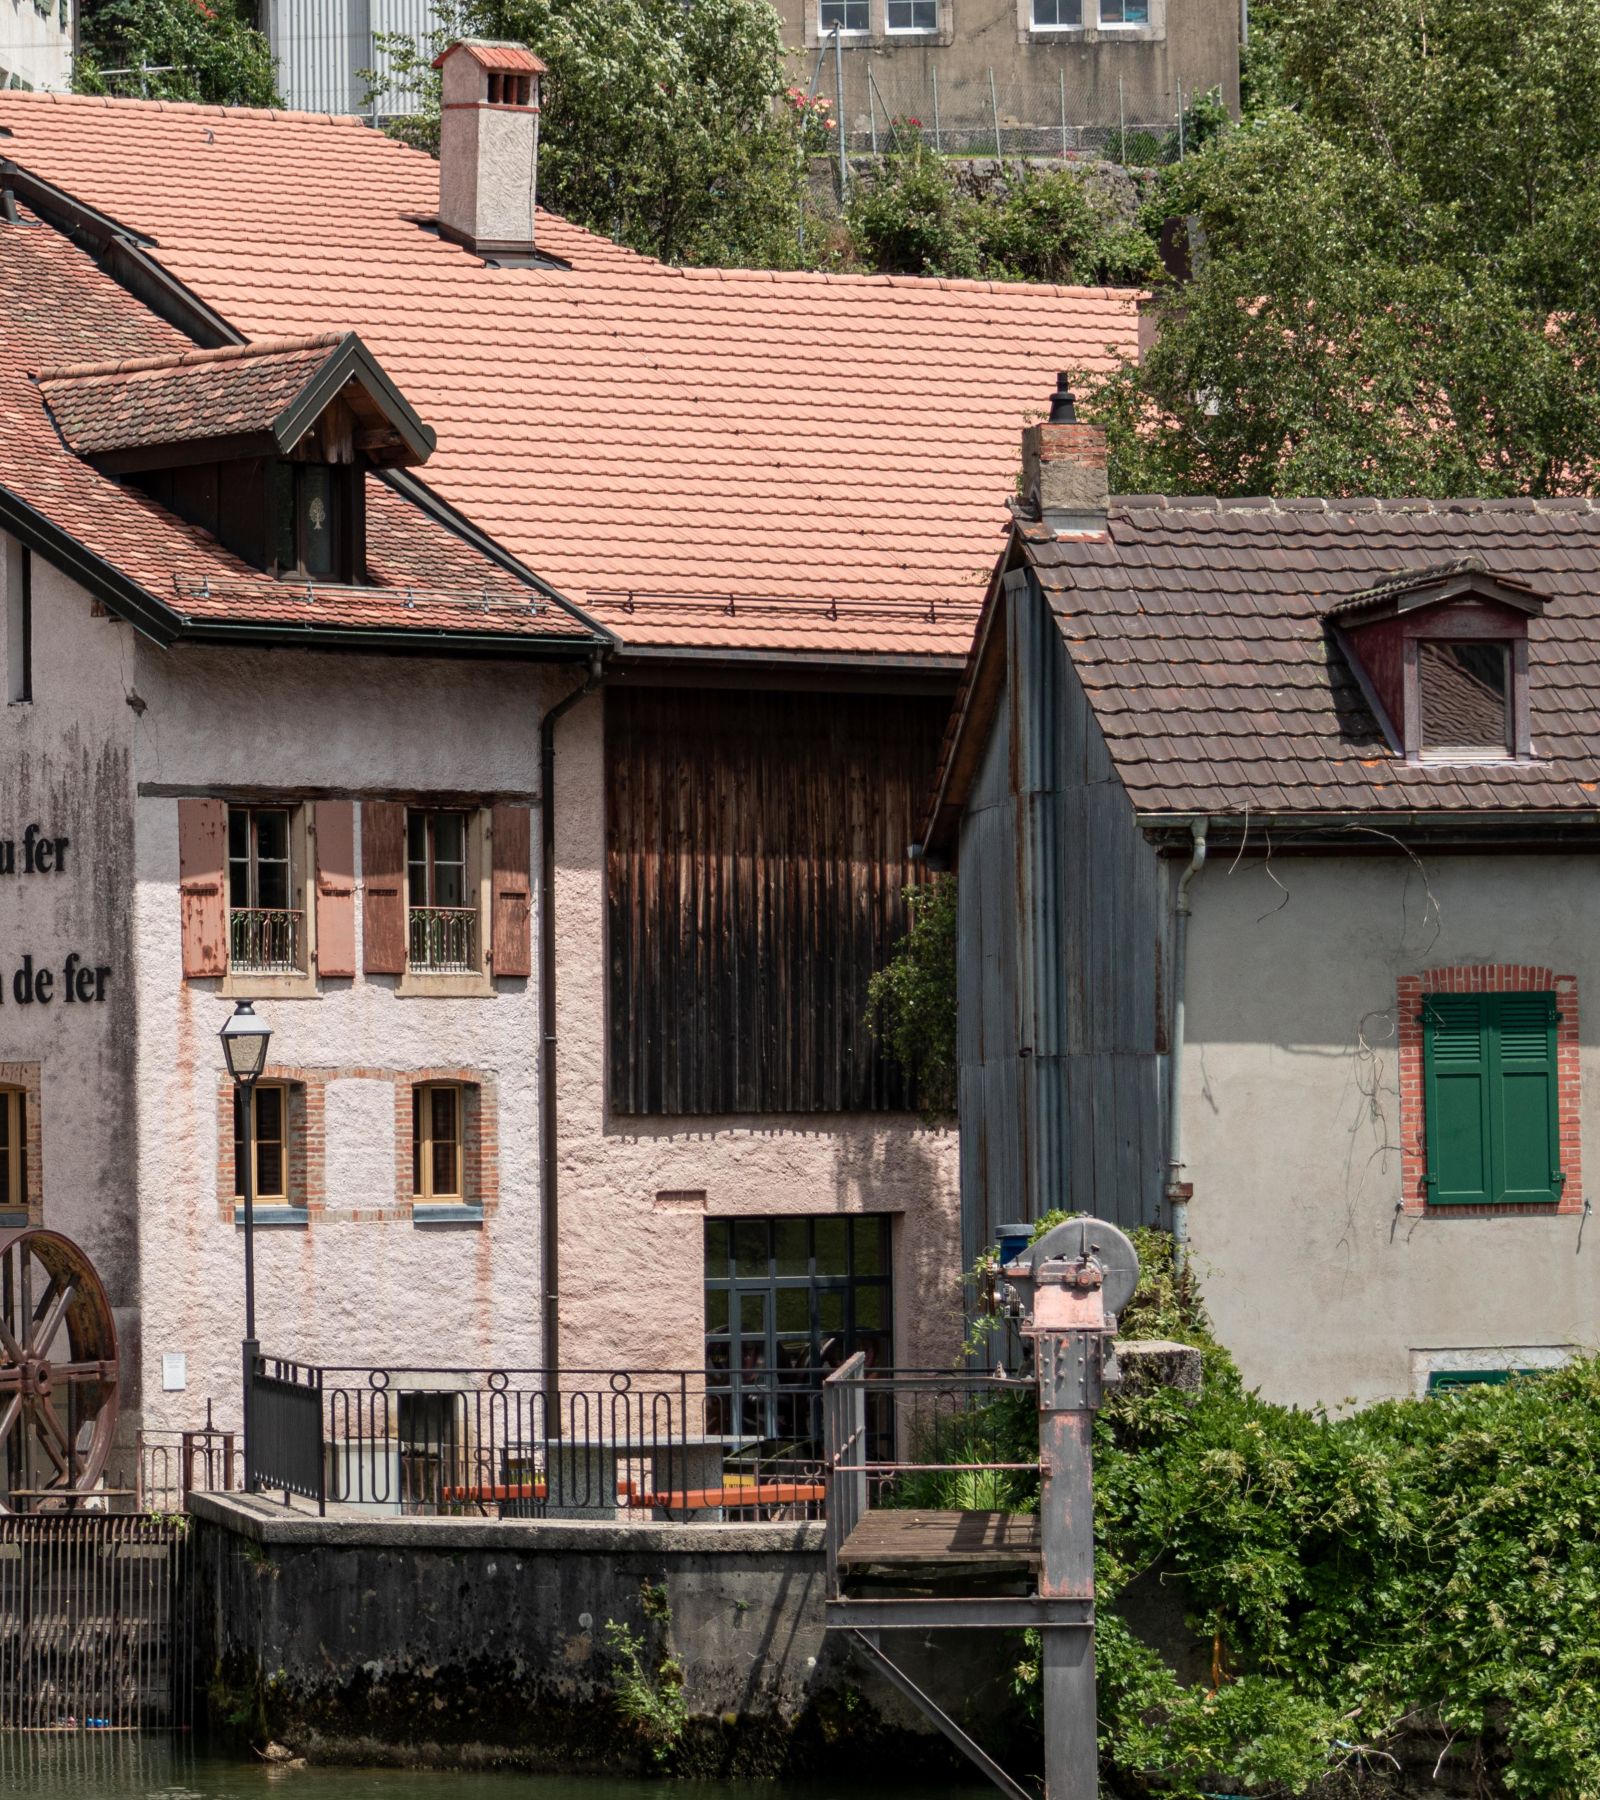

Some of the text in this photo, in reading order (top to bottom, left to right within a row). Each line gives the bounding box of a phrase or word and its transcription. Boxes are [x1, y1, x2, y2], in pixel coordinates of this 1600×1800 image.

[23, 823, 69, 874] fer
[13, 954, 53, 1005] de
[63, 952, 111, 1003] fer
